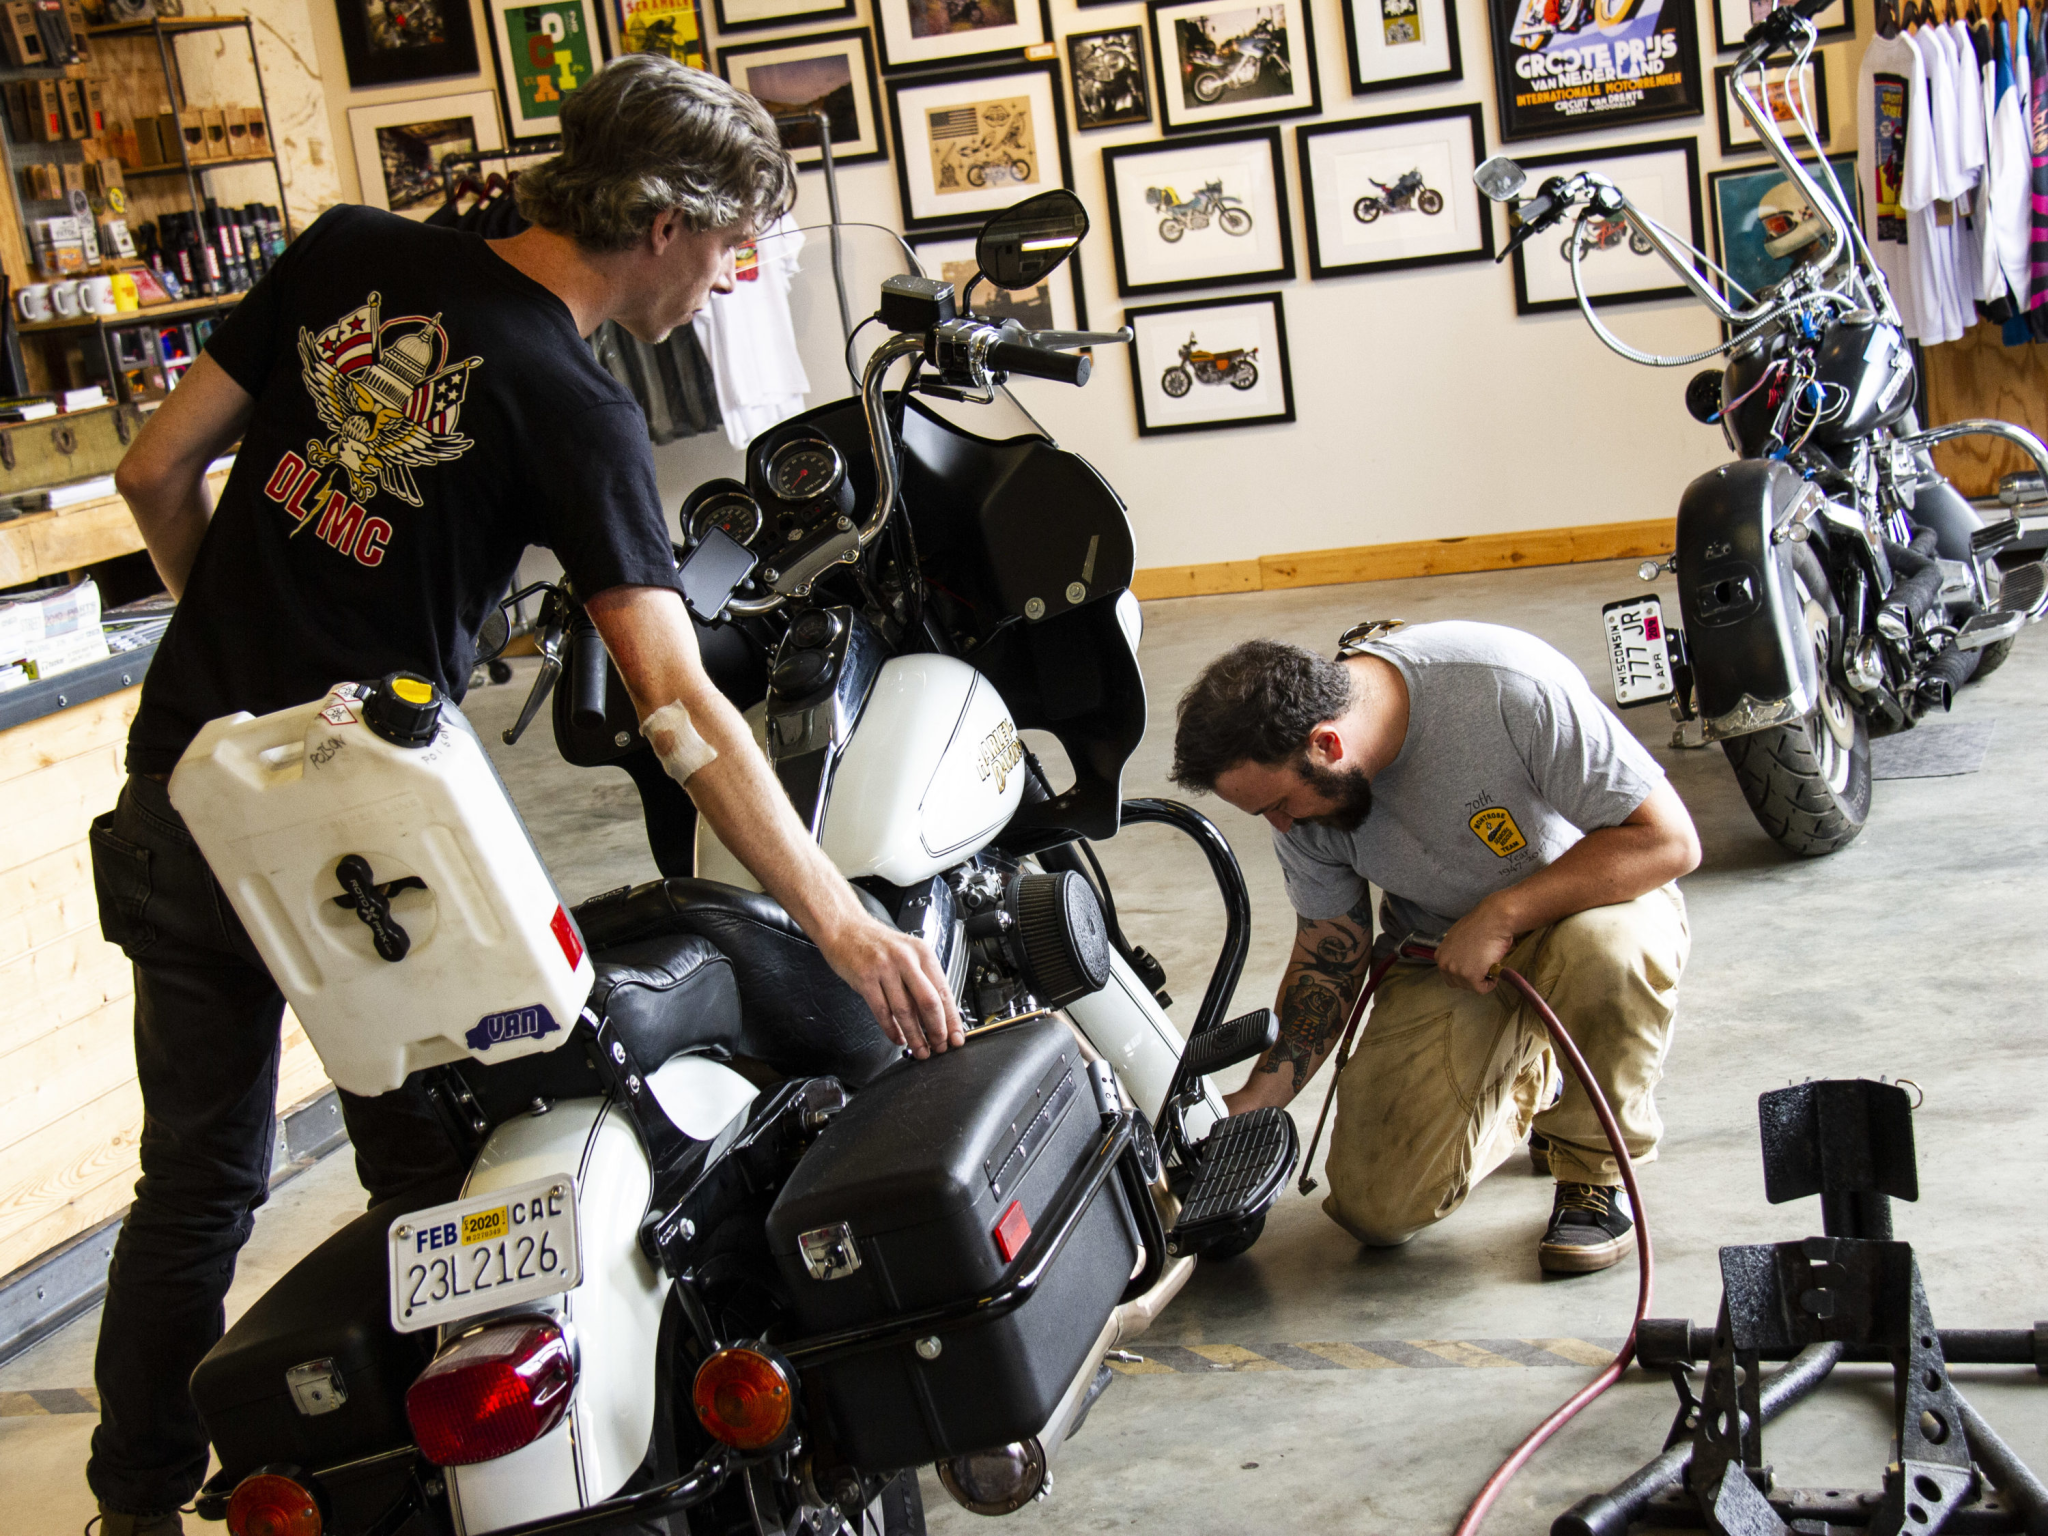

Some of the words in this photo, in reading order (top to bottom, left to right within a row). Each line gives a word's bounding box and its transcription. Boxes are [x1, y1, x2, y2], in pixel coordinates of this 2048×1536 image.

[1515, 43, 1613, 79] GROOTE
[1614, 33, 1678, 67] PRIJS
[1516, 84, 1601, 107] INTERNATIONALE
[1605, 72, 1682, 94] MOTORRENNEN
[1531, 78, 1557, 92] VAN
[1557, 59, 1665, 89] NEDERLAND
[1554, 97, 1589, 112] CIRCUIT
[1621, 611, 1644, 636] JR
[1611, 625, 1628, 687] WISCONSIN
[1626, 647, 1652, 686] 777
[1653, 653, 1665, 677] APR
[310, 735, 347, 770] POISON
[1465, 789, 1494, 815] 70th
[1474, 812, 1506, 830] MONTROSE
[1501, 840, 1519, 853] TEAM
[487, 1008, 539, 1041] VAN
[469, 1212, 500, 1232] 2020
[513, 1195, 562, 1225] CAL
[416, 1222, 458, 1253] FEB
[408, 1231, 558, 1308] 23L2126
